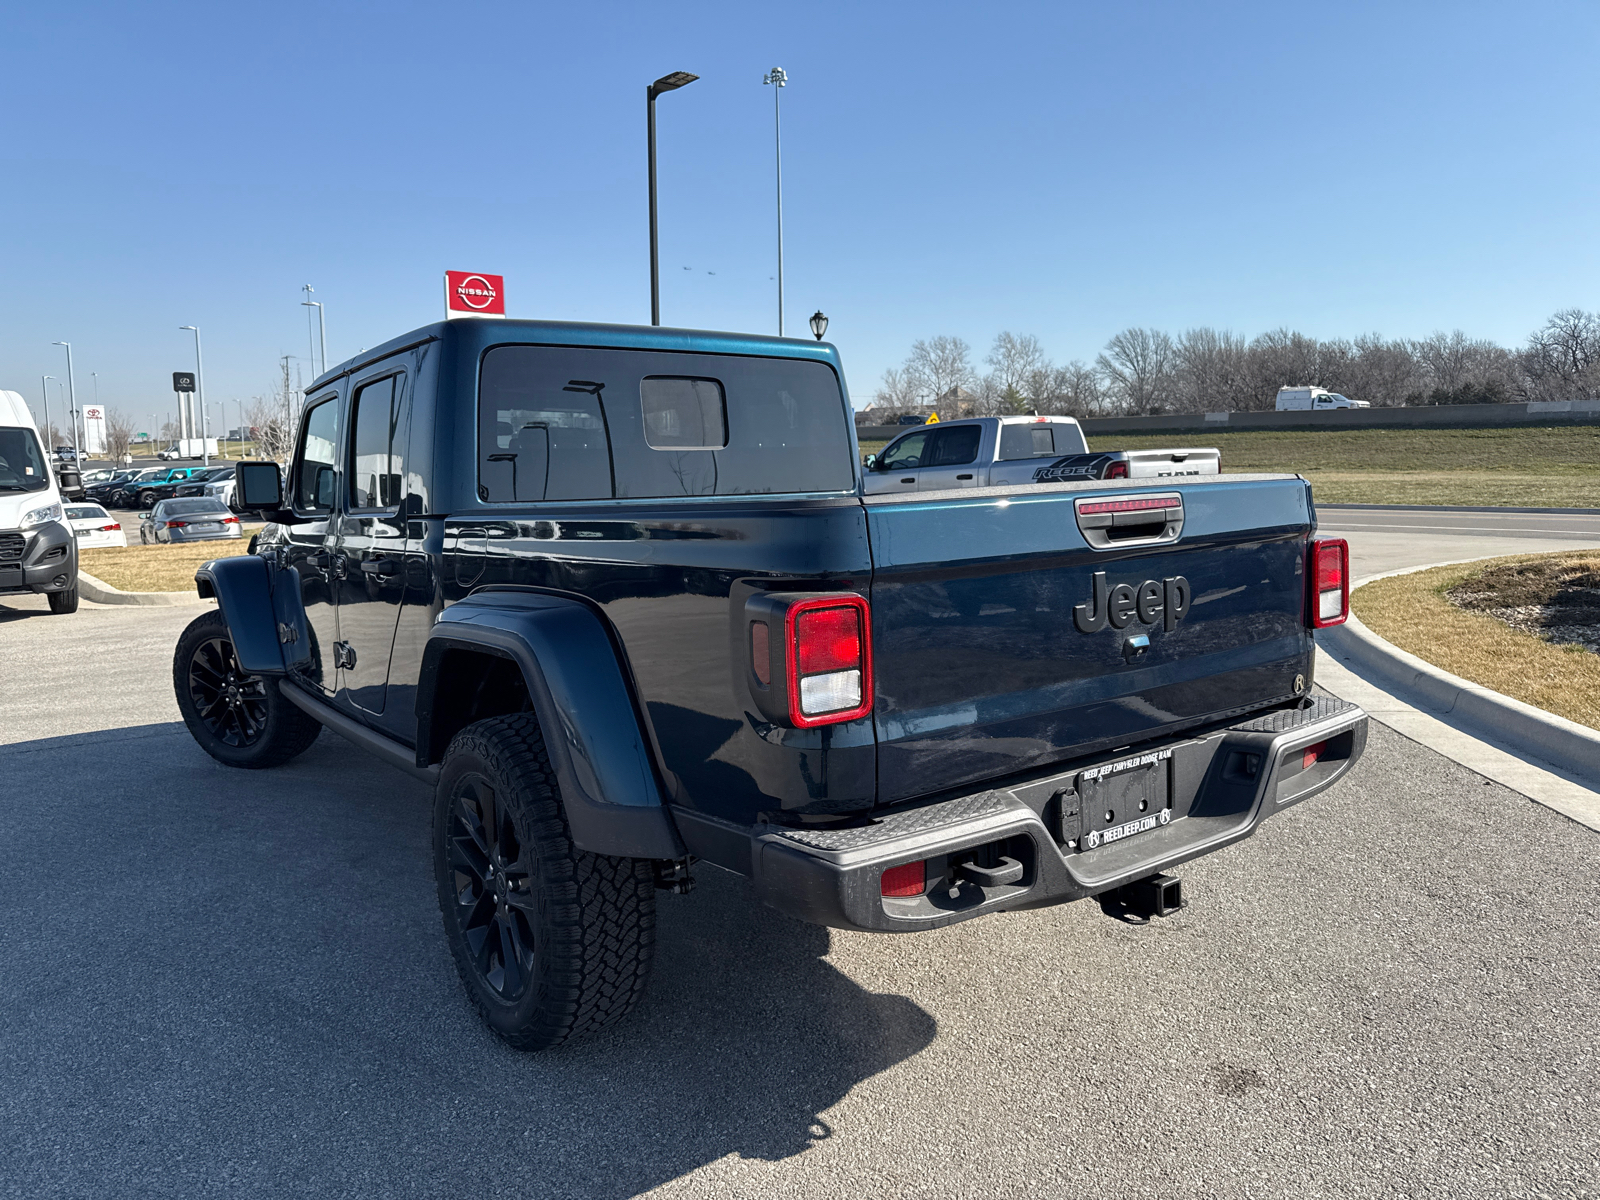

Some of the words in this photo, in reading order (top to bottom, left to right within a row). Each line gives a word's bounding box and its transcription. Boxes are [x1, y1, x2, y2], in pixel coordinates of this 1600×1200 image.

[458, 287, 496, 297] NISSAN
[1032, 465, 1098, 480] REBEL
[1073, 571, 1191, 633] Jeep
[1083, 768, 1098, 780] REED
[1113, 757, 1140, 772] CHRYSLER
[1141, 753, 1158, 765] DODGE
[1158, 749, 1172, 760] RAM
[1103, 816, 1156, 843] REEDJEEP.COM
